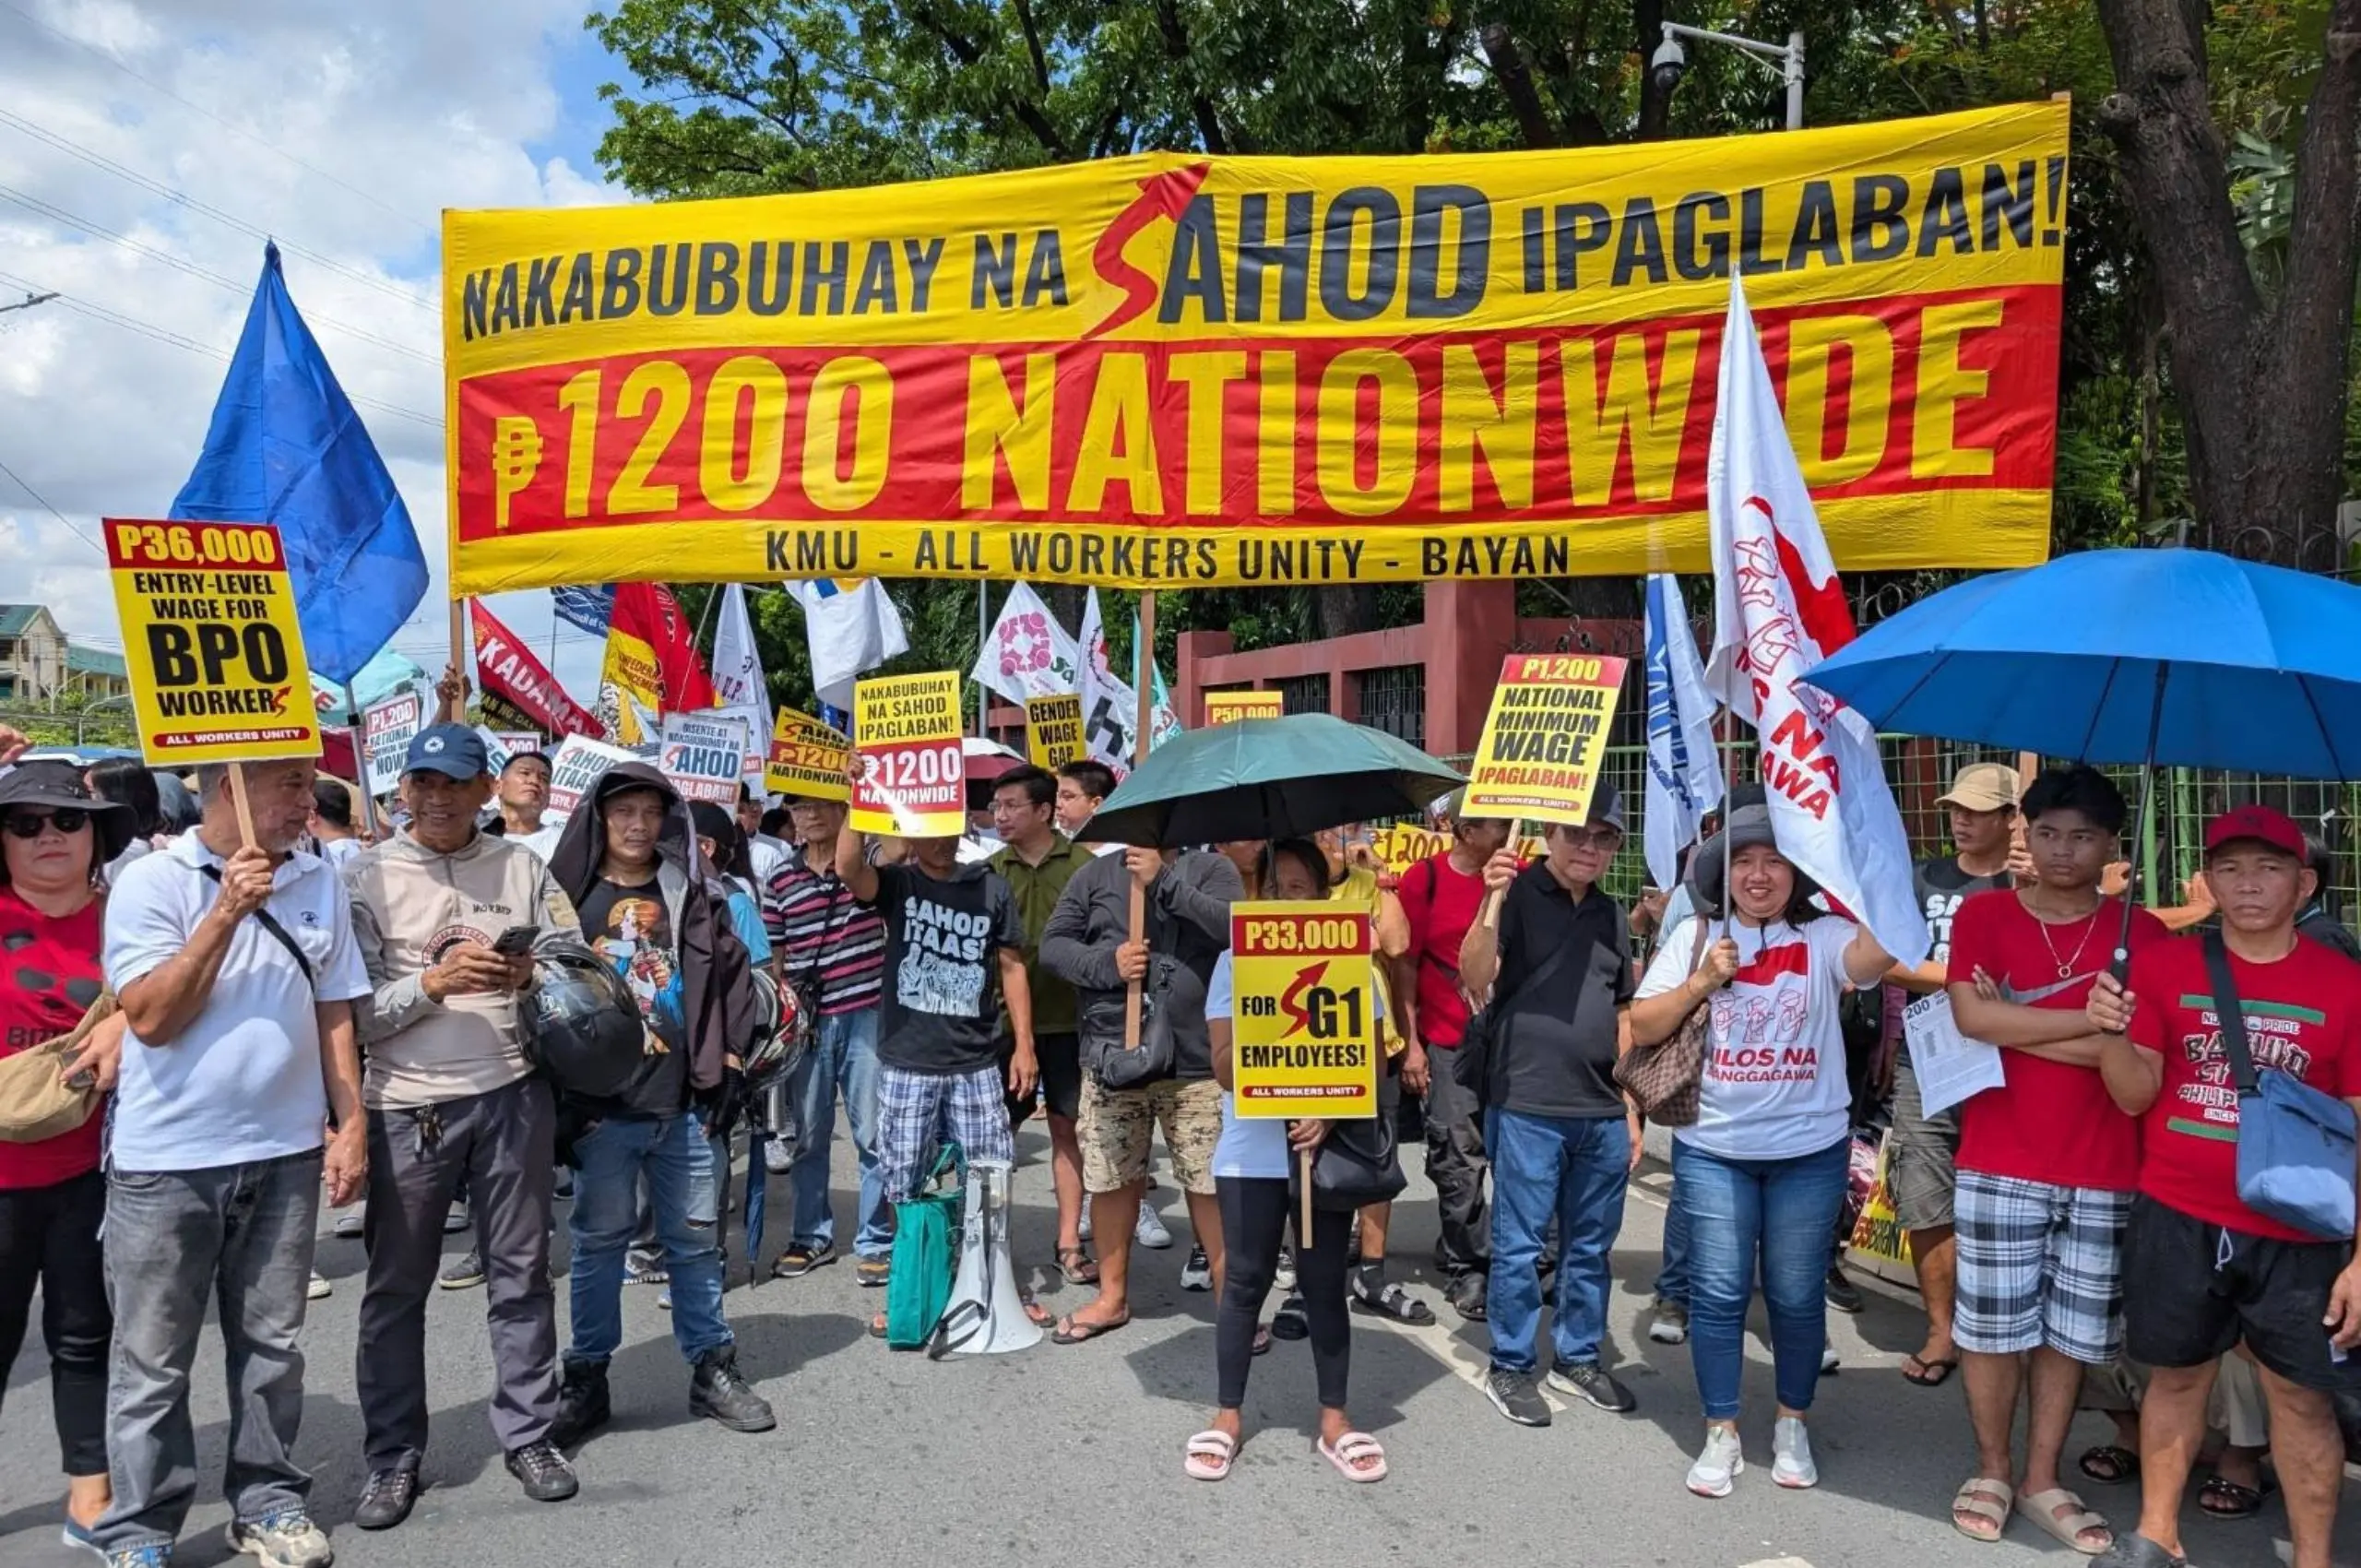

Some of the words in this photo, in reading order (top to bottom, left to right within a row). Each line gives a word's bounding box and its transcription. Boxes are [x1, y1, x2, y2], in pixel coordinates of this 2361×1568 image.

[463, 237, 946, 342] NAKABUBUHAY
[970, 230, 1068, 310] NA
[1081, 162, 1492, 339] SAHOD
[1523, 156, 2067, 294] IPAGLABAN!
[961, 299, 2004, 516] NATIONWDE
[116, 525, 276, 565] P36,000
[767, 530, 859, 572] KMU
[915, 530, 989, 573] ALL
[1010, 531, 1216, 579] WORKERS
[1240, 539, 1365, 579] UNITY
[1422, 536, 1570, 576] BAYAN
[134, 572, 276, 595] ENTRY-LEVEL
[151, 599, 221, 620] WAGE
[225, 599, 267, 620] FOR
[147, 623, 289, 686] BPO
[1522, 658, 1602, 682] P1,200
[157, 685, 291, 719] WORKERS
[860, 679, 954, 702] NAKABUBUHAY
[1501, 687, 1605, 710] NATIONAL
[867, 702, 887, 720] NA
[893, 696, 947, 718] SAHOD
[1029, 698, 1081, 724] GENDER
[1212, 706, 1278, 724] P50000
[860, 716, 955, 742] IPAGLABAN!
[1038, 722, 1078, 746] WAGE
[1494, 711, 1601, 735] MINIMUM
[166, 734, 193, 745] ALL
[195, 731, 259, 743] WORKERS
[262, 729, 301, 739] UNITY
[1491, 731, 1590, 766] WAGE
[664, 744, 739, 779] SAHOD
[1048, 745, 1074, 768] GAP
[1477, 766, 1589, 791] IPAGLABAN!
[904, 896, 991, 939] SAHOD
[1245, 920, 1358, 953] P33,000
[1241, 995, 1276, 1016] FOR
[2262, 1018, 2301, 1035] PRIDE
[1240, 1045, 1367, 1068] EMPLOYEES!
[1782, 1047, 1817, 1066] NA
[1251, 1087, 1271, 1097] ALL
[1273, 1087, 1325, 1097] WORKERS
[1326, 1087, 1359, 1096] UNITY
[2177, 1084, 2240, 1109] PHILIP
